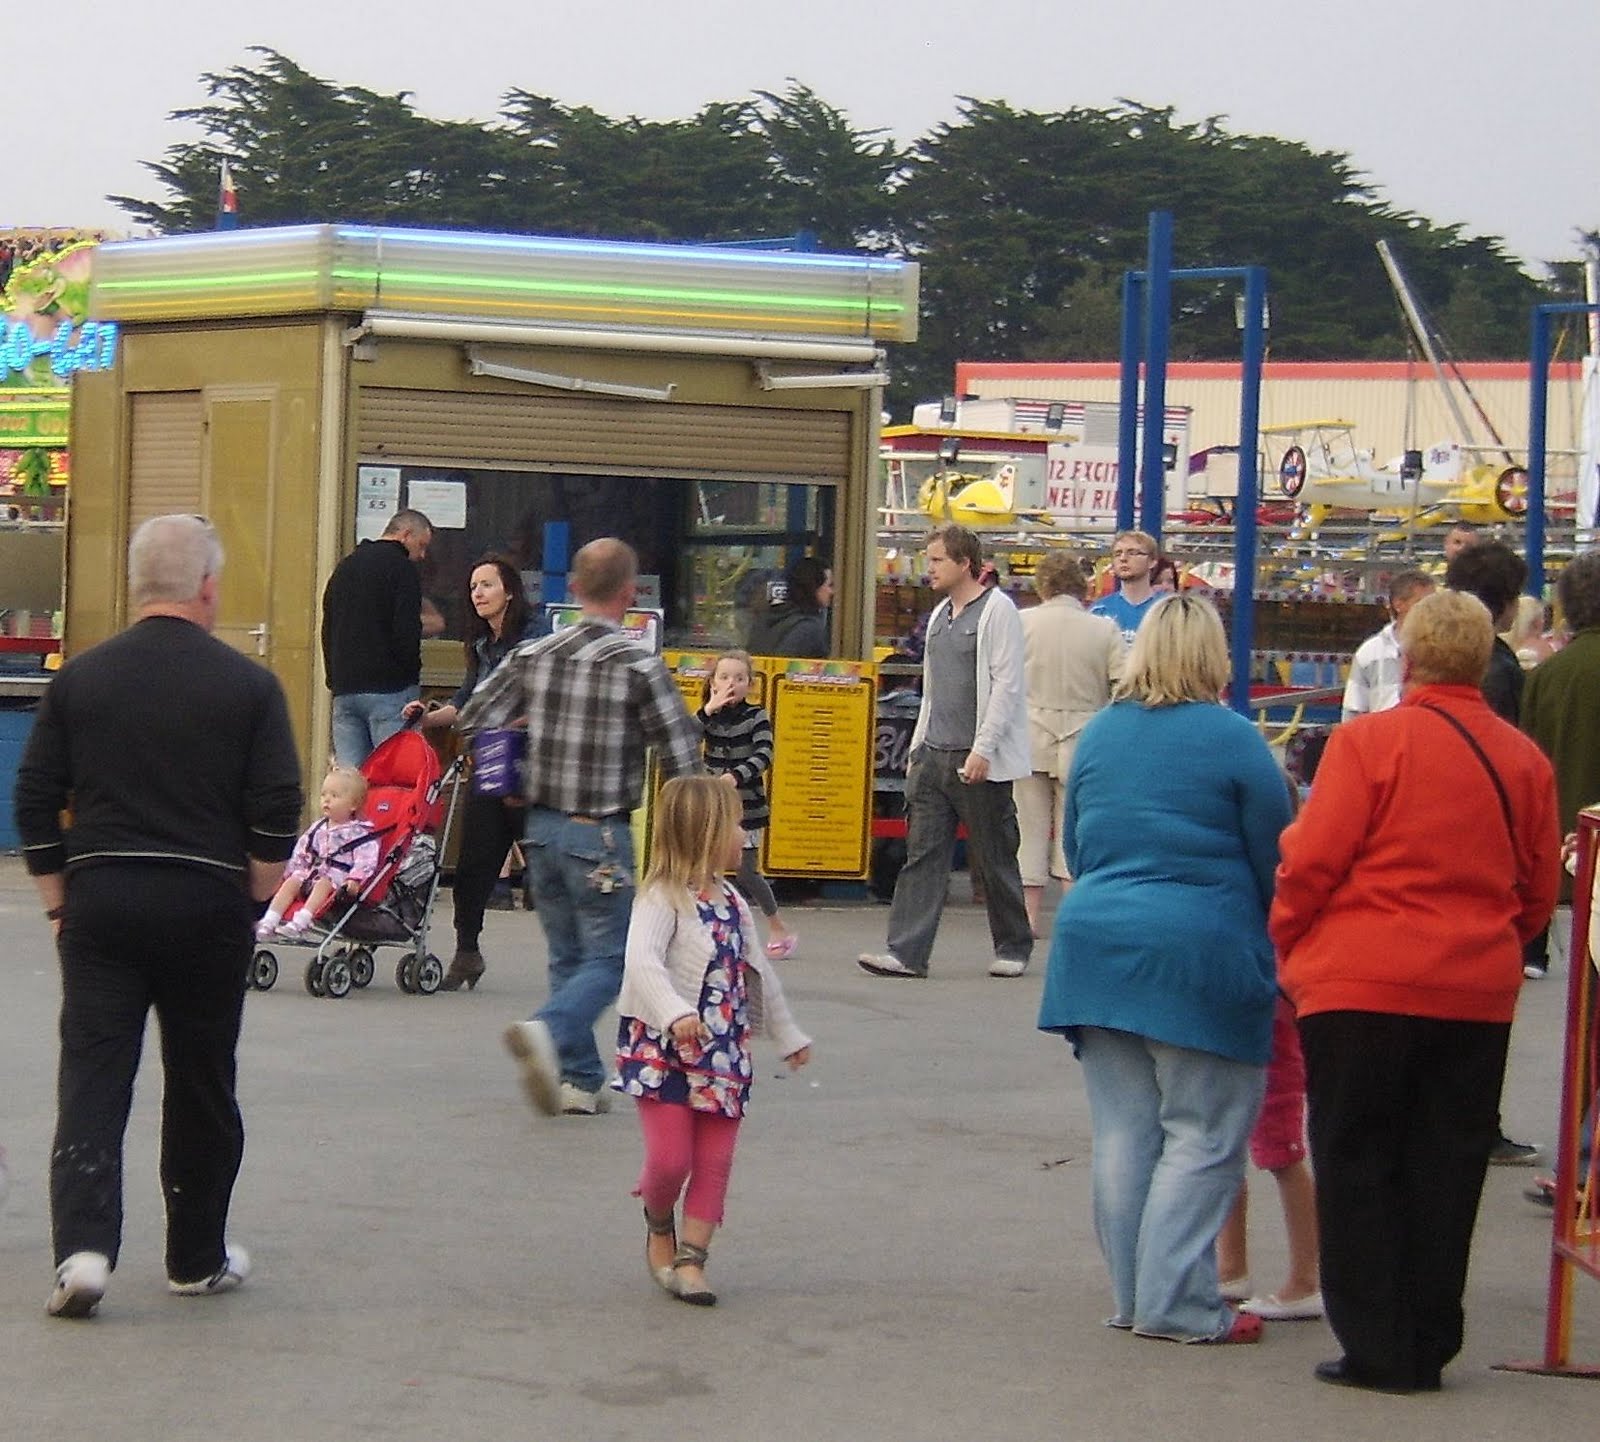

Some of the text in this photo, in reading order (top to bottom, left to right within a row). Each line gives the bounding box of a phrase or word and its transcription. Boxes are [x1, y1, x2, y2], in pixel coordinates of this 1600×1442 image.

[1049, 460, 1119, 482] 12 EXCIT
[370, 477, 387, 487] £5
[368, 500, 386, 510] £5
[1048, 487, 1085, 508] NEW
